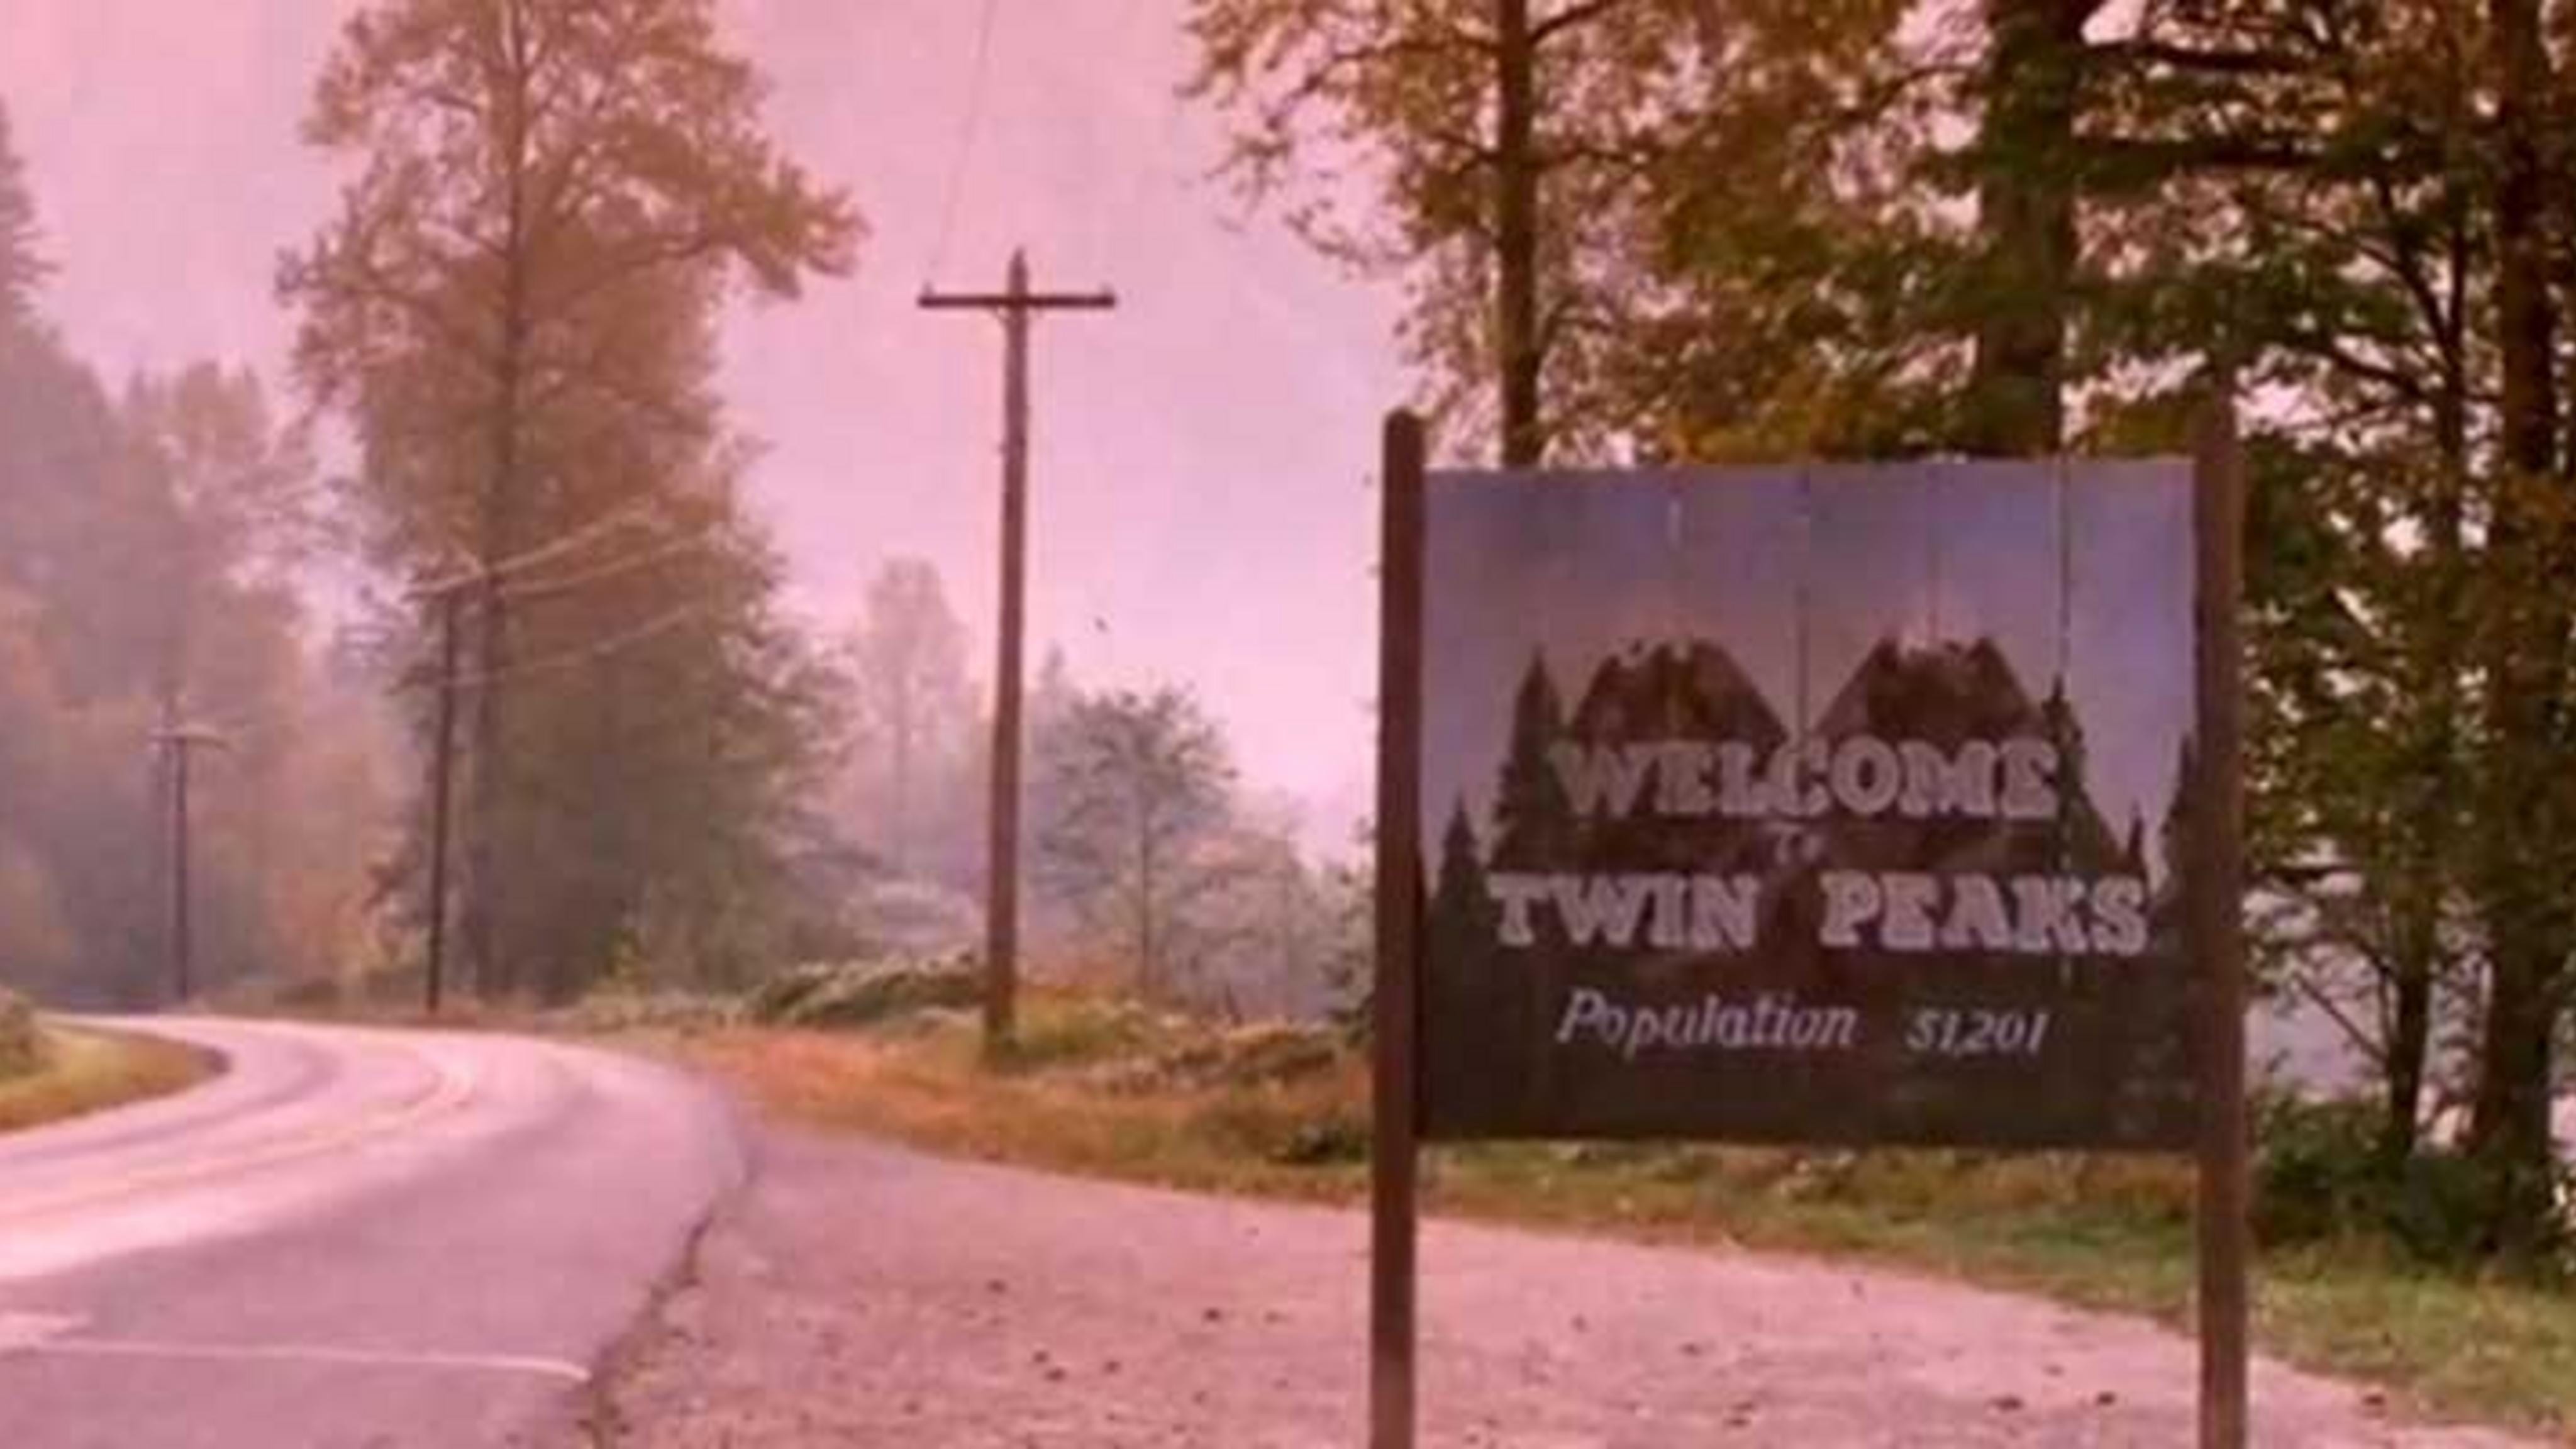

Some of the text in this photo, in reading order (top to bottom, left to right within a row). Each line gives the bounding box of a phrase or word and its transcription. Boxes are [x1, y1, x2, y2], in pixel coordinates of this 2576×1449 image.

[1548, 736, 2058, 819] WELCOME
[1488, 872, 2148, 955] TWIN PEAKS
[1556, 987, 2049, 1060] Population 51,201
